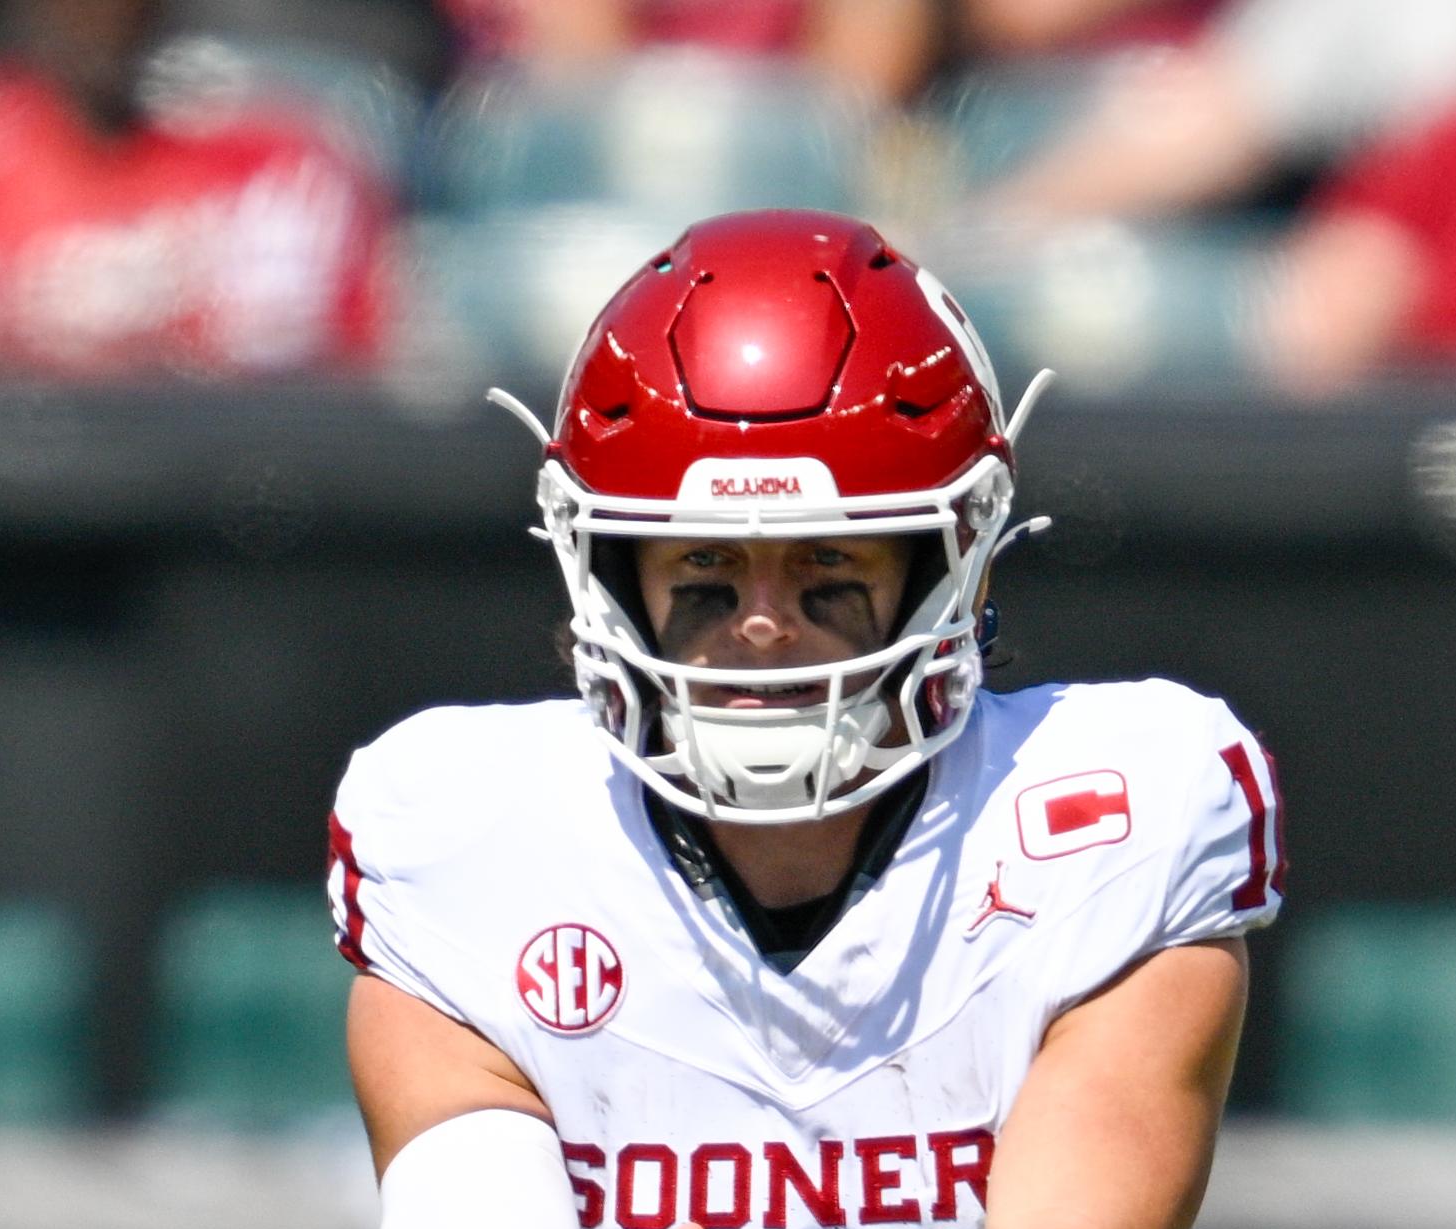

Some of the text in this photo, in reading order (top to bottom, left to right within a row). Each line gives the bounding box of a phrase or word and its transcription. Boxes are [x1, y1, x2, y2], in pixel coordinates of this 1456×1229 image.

[711, 476, 802, 496] OKLAHOMA
[1218, 731, 1289, 912] 1
[517, 925, 622, 1027] SEC
